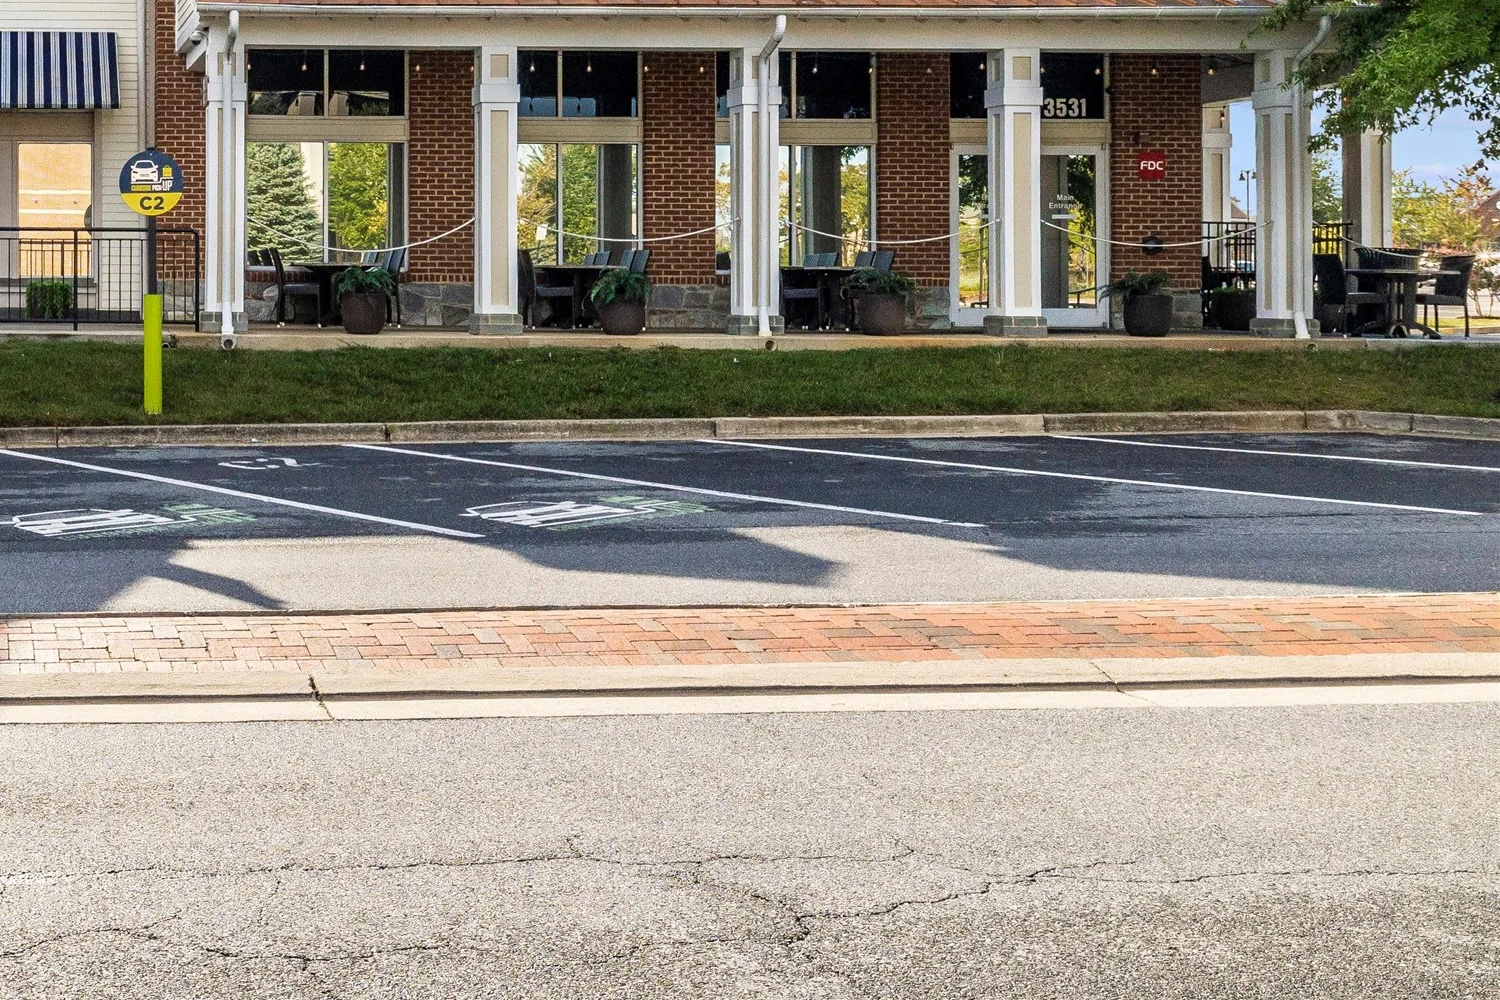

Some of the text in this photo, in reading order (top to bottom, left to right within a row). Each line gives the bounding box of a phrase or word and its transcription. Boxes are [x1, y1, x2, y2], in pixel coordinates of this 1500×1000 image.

[1044, 98, 1086, 117] 3531
[1140, 160, 1164, 170] FDC
[139, 196, 165, 210] C2
